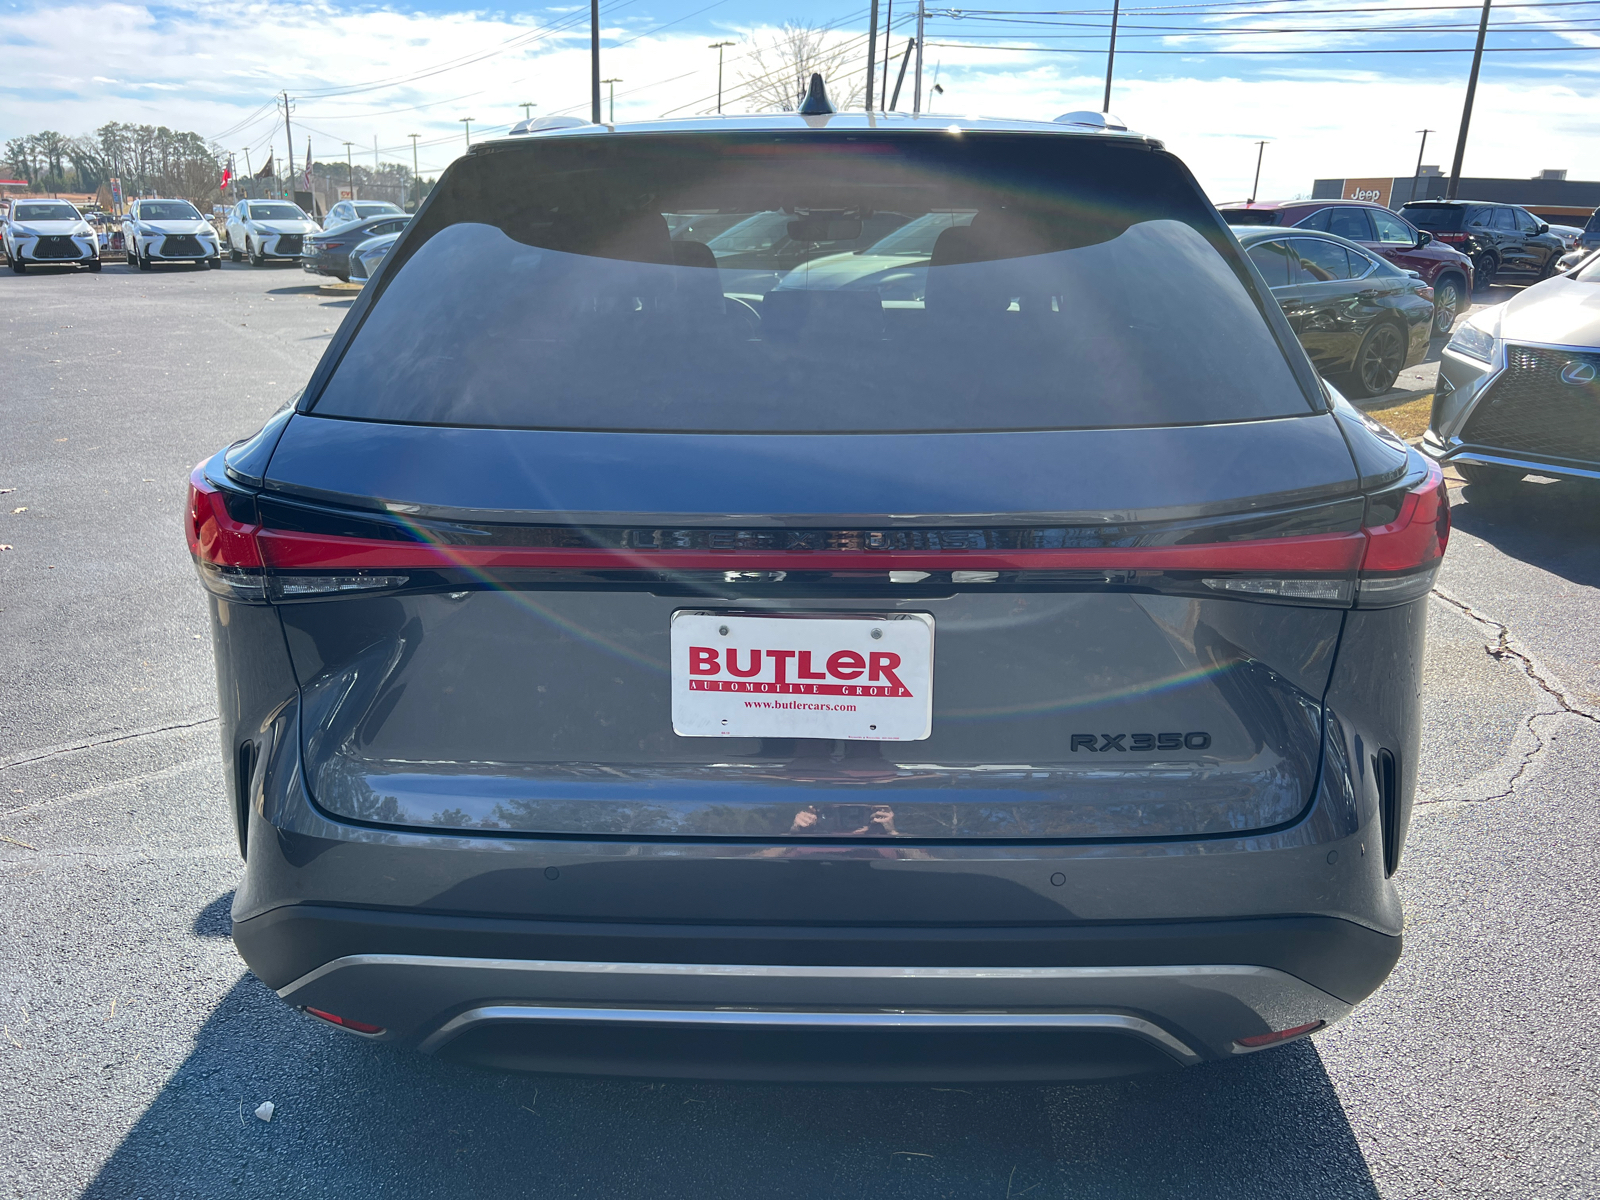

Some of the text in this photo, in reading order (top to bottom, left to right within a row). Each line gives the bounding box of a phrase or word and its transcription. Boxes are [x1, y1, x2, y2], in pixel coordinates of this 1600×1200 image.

[1351, 187, 1380, 202] Jeep
[632, 529, 970, 550] LEXUS
[690, 680, 905, 696] AUTOMOTIVE GROUP
[744, 700, 857, 712] www.butlercars.com
[1071, 731, 1212, 752] RX350
